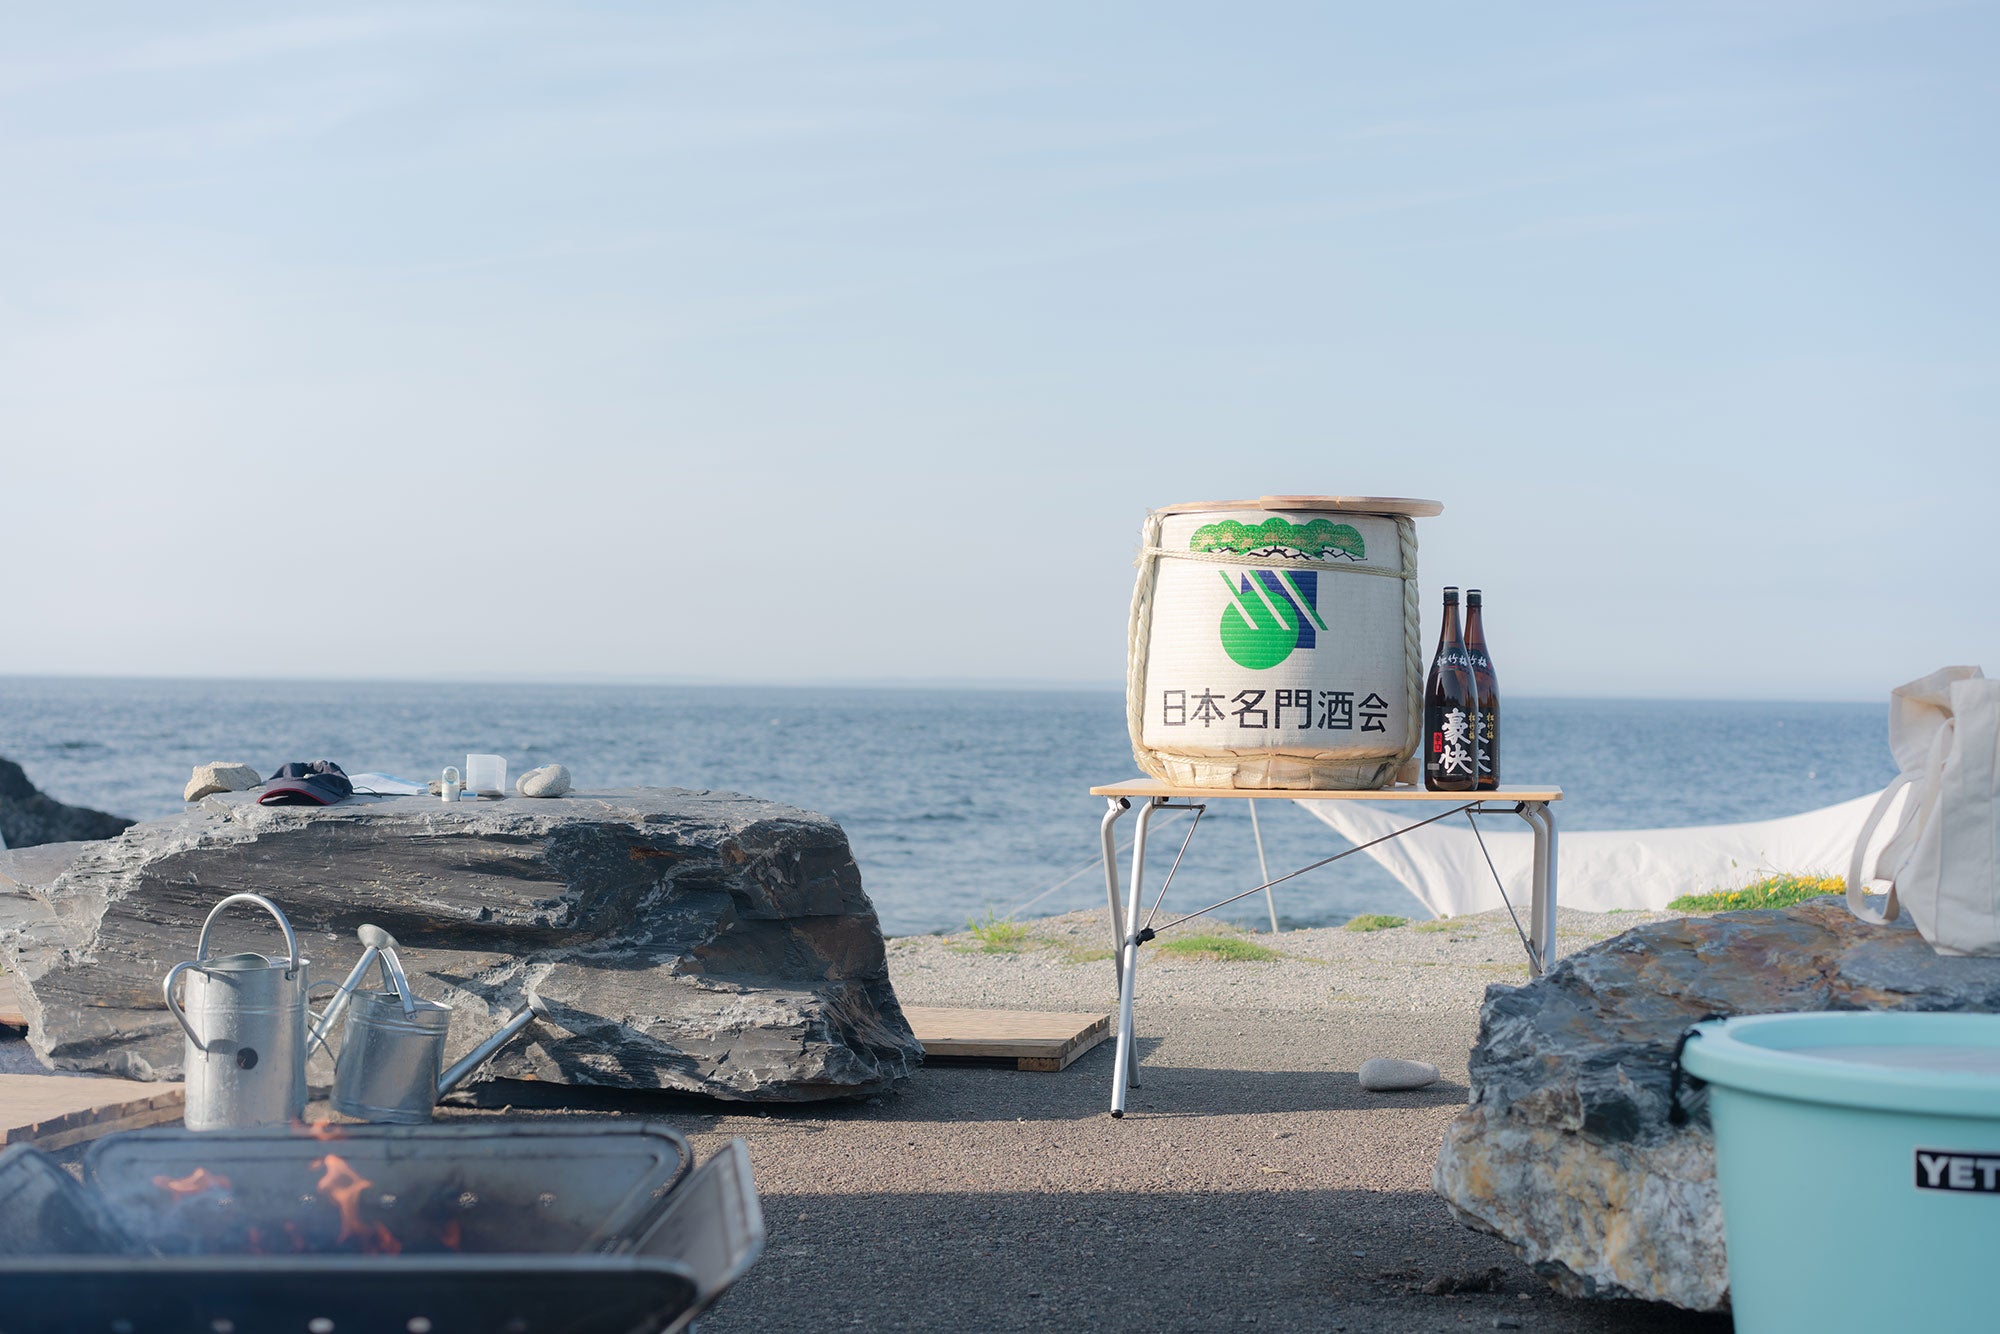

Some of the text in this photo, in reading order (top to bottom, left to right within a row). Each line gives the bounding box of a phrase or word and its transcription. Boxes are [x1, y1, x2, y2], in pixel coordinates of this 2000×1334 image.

[1468, 654, 1488, 668] 竹梅
[1163, 687, 1389, 733] 日本名門酒会
[1438, 707, 1473, 774] 豪快
